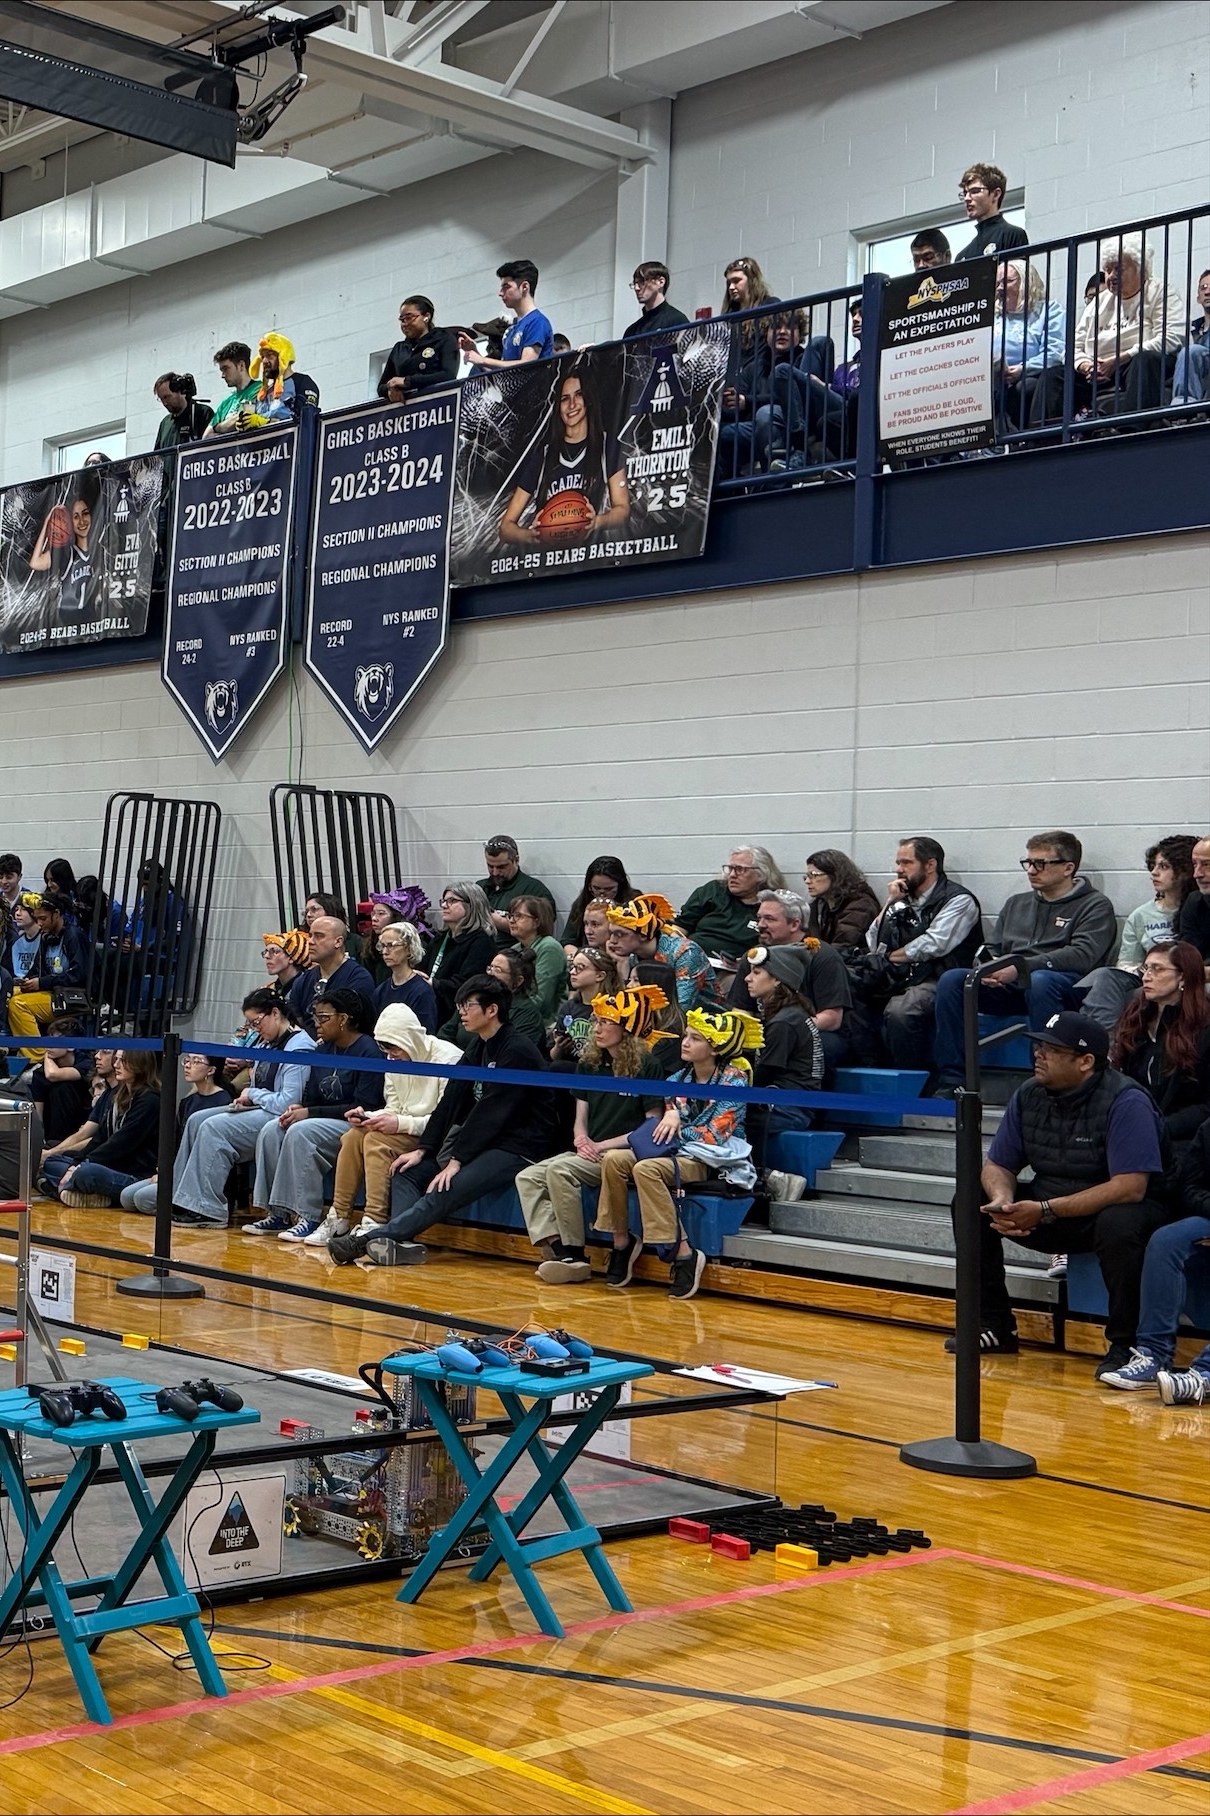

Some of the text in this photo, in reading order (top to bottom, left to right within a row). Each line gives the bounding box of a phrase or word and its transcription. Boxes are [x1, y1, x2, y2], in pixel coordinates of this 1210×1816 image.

[917, 277, 969, 299] NYSPHSAA
[888, 299, 988, 330] SPORTSMANSHIP IS
[893, 313, 981, 342] AN EXPECTATION
[895, 337, 975, 360] LET THE PLAYERS PLAY
[890, 356, 980, 381] LET THE COACHES COACH
[883, 374, 986, 401] LET THE OFFICIALS OFFICIATE
[887, 403, 983, 428] BE PROUD AND BE POSITIVE
[893, 396, 976, 418] FANS SHOULD BE LOUD,
[327, 405, 453, 450] GIRLS BASKETBALL
[651, 424, 694, 451] EMILY
[888, 425, 987, 449] WHEN EVERYONE KNOWS THEIR
[364, 444, 409, 467] CLASS B
[915, 440, 948, 453] STUDENTS
[949, 435, 979, 448] BENEFIT!
[182, 443, 290, 480] GIRLS BASKETBALL
[626, 448, 691, 478] THORNTON
[215, 477, 252, 498] CLASS B
[329, 454, 443, 504] 2023-2024
[183, 487, 283, 531] 2022-2023
[125, 533, 140, 551] EVA
[322, 514, 442, 549] SECTION II CHAMPIONS
[178, 543, 281, 572] SECTION II CHAMPIONS
[491, 534, 678, 573] 2024-25 BEARS BASKETBALL
[71, 565, 95, 584] ACADE
[321, 554, 437, 586] REGIONAL CHAMPIONS
[177, 580, 277, 607] REGIONAL CHAMPIONS
[320, 619, 353, 634] RECORD
[382, 607, 438, 626] NYS RANKED
[50, 625, 78, 639] BEARS
[229, 629, 277, 646] NYS RANKED
[327, 636, 345, 648] 22-4
[402, 626, 415, 638] #2
[176, 639, 203, 652] RECORD
[245, 646, 256, 657] #3
[181, 653, 197, 665] 24-2
[220, 1525, 250, 1539] INTO THE
[225, 1538, 244, 1548] DEEP
